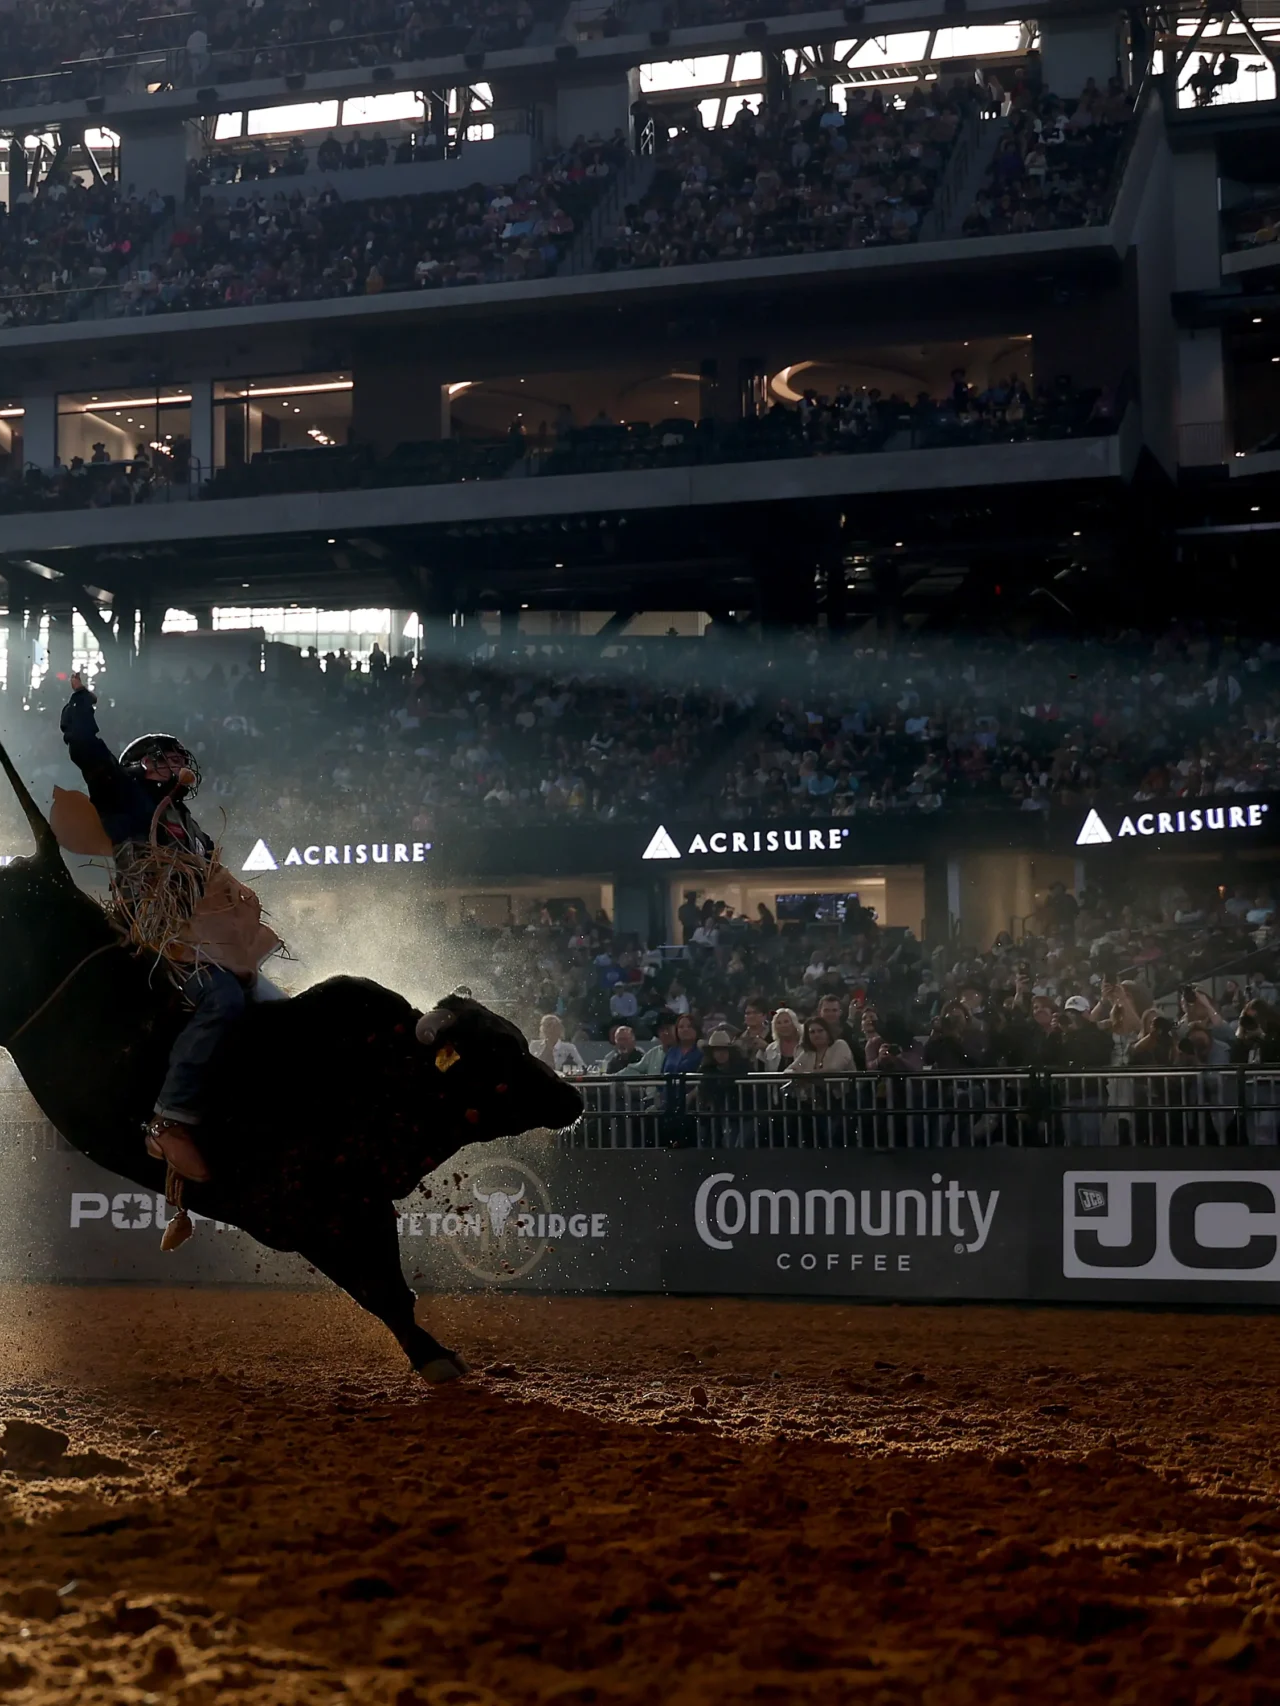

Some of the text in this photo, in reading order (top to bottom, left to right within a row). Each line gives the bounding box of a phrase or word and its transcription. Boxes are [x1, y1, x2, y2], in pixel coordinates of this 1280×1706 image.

[1117, 804, 1262, 837] ACRISURE
[283, 842, 426, 866] ACRISURE
[687, 828, 843, 855] ACRISURE
[396, 1212, 607, 1239] TETON RIDGE
[693, 1172, 1000, 1253] Community
[777, 1252, 911, 1272] COFFEE
